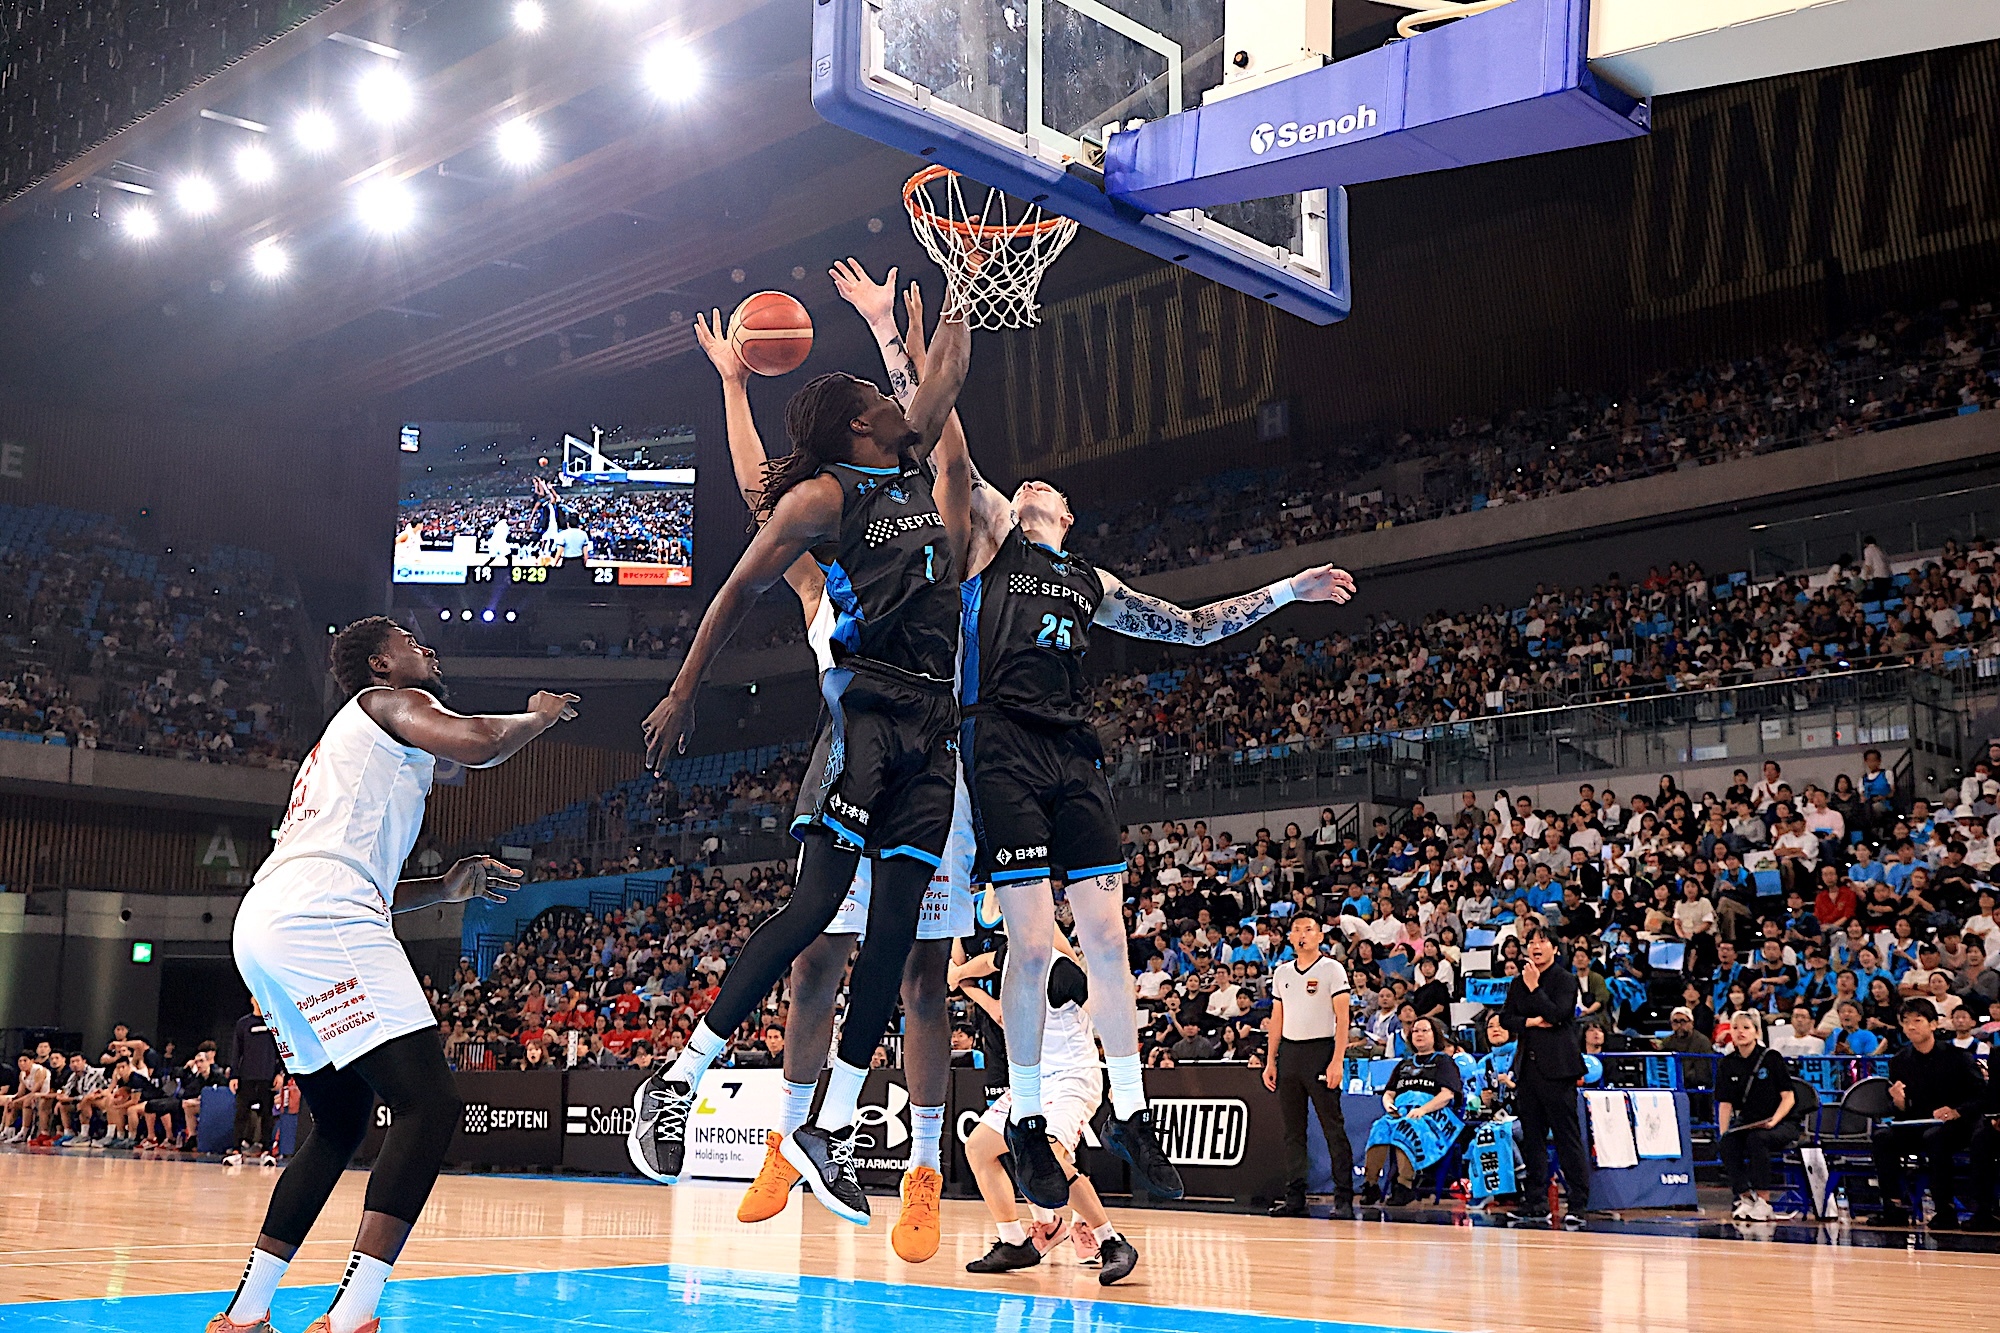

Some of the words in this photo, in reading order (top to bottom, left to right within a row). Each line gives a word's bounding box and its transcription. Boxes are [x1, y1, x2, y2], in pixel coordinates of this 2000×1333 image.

[1277, 104, 1377, 148] Senoh
[512, 566, 547, 582] 9:29
[594, 567, 614, 583] 25
[1035, 613, 1074, 650] 25
[202, 829, 240, 868] A
[336, 1012, 376, 1035] KOUSAN
[490, 1110, 548, 1129] SEPTENI
[590, 1107, 635, 1135] SoftB
[695, 1149, 727, 1162] Holdings
[729, 1150, 744, 1162] Inc.
